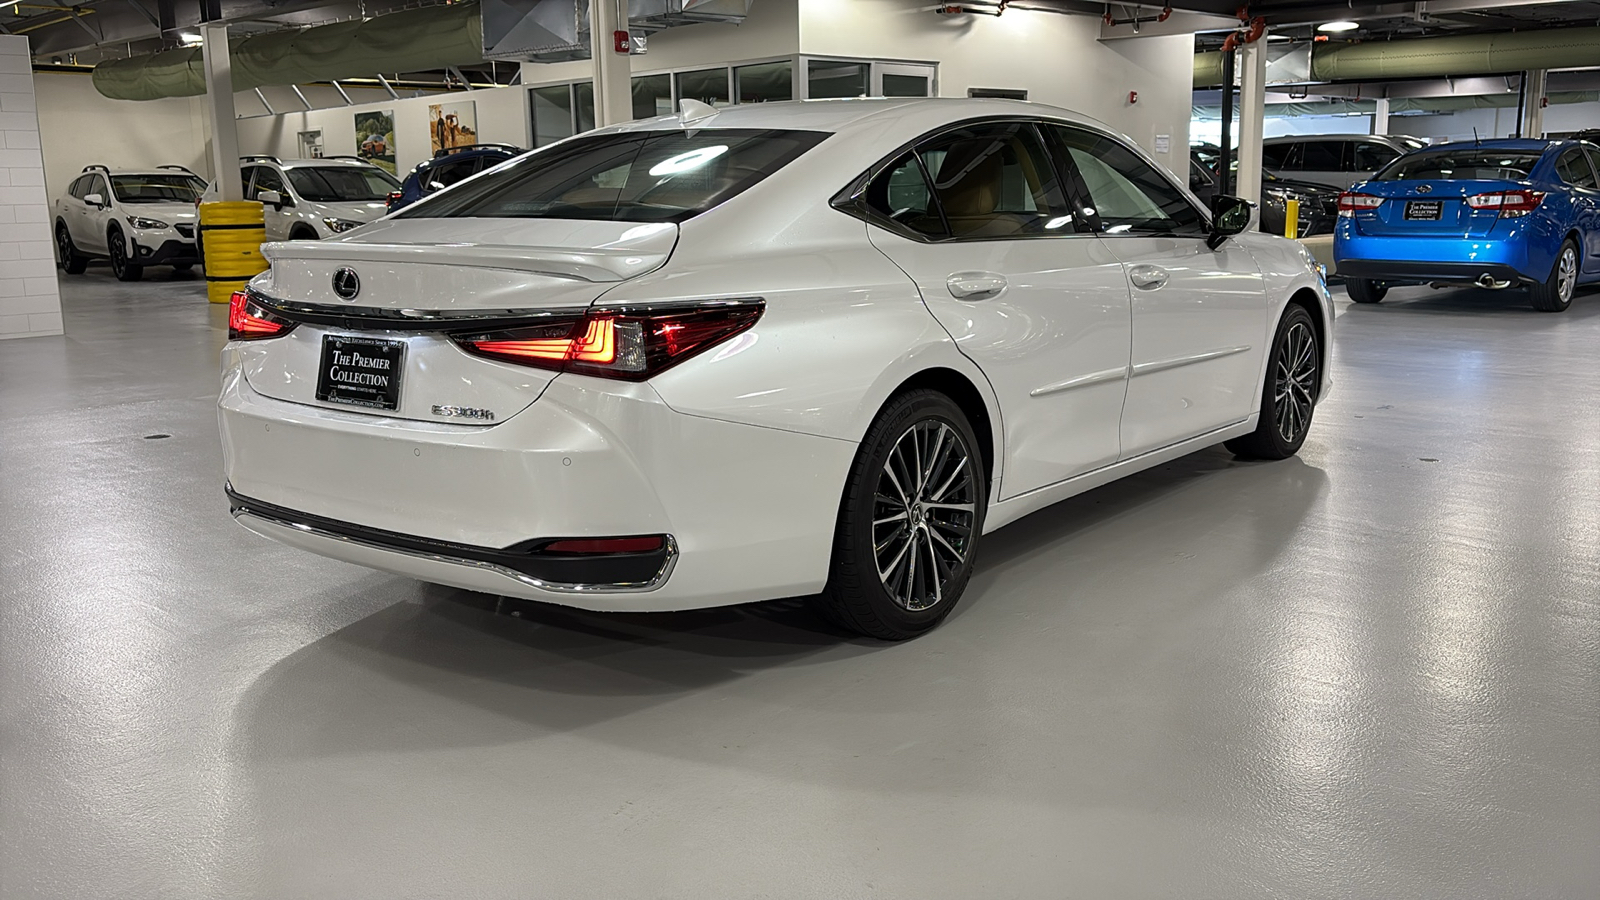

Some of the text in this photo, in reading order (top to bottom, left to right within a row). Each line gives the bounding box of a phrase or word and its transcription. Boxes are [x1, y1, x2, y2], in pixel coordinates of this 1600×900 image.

[332, 350, 390, 370] THE PREMIER
[329, 365, 389, 387] COLLECTION
